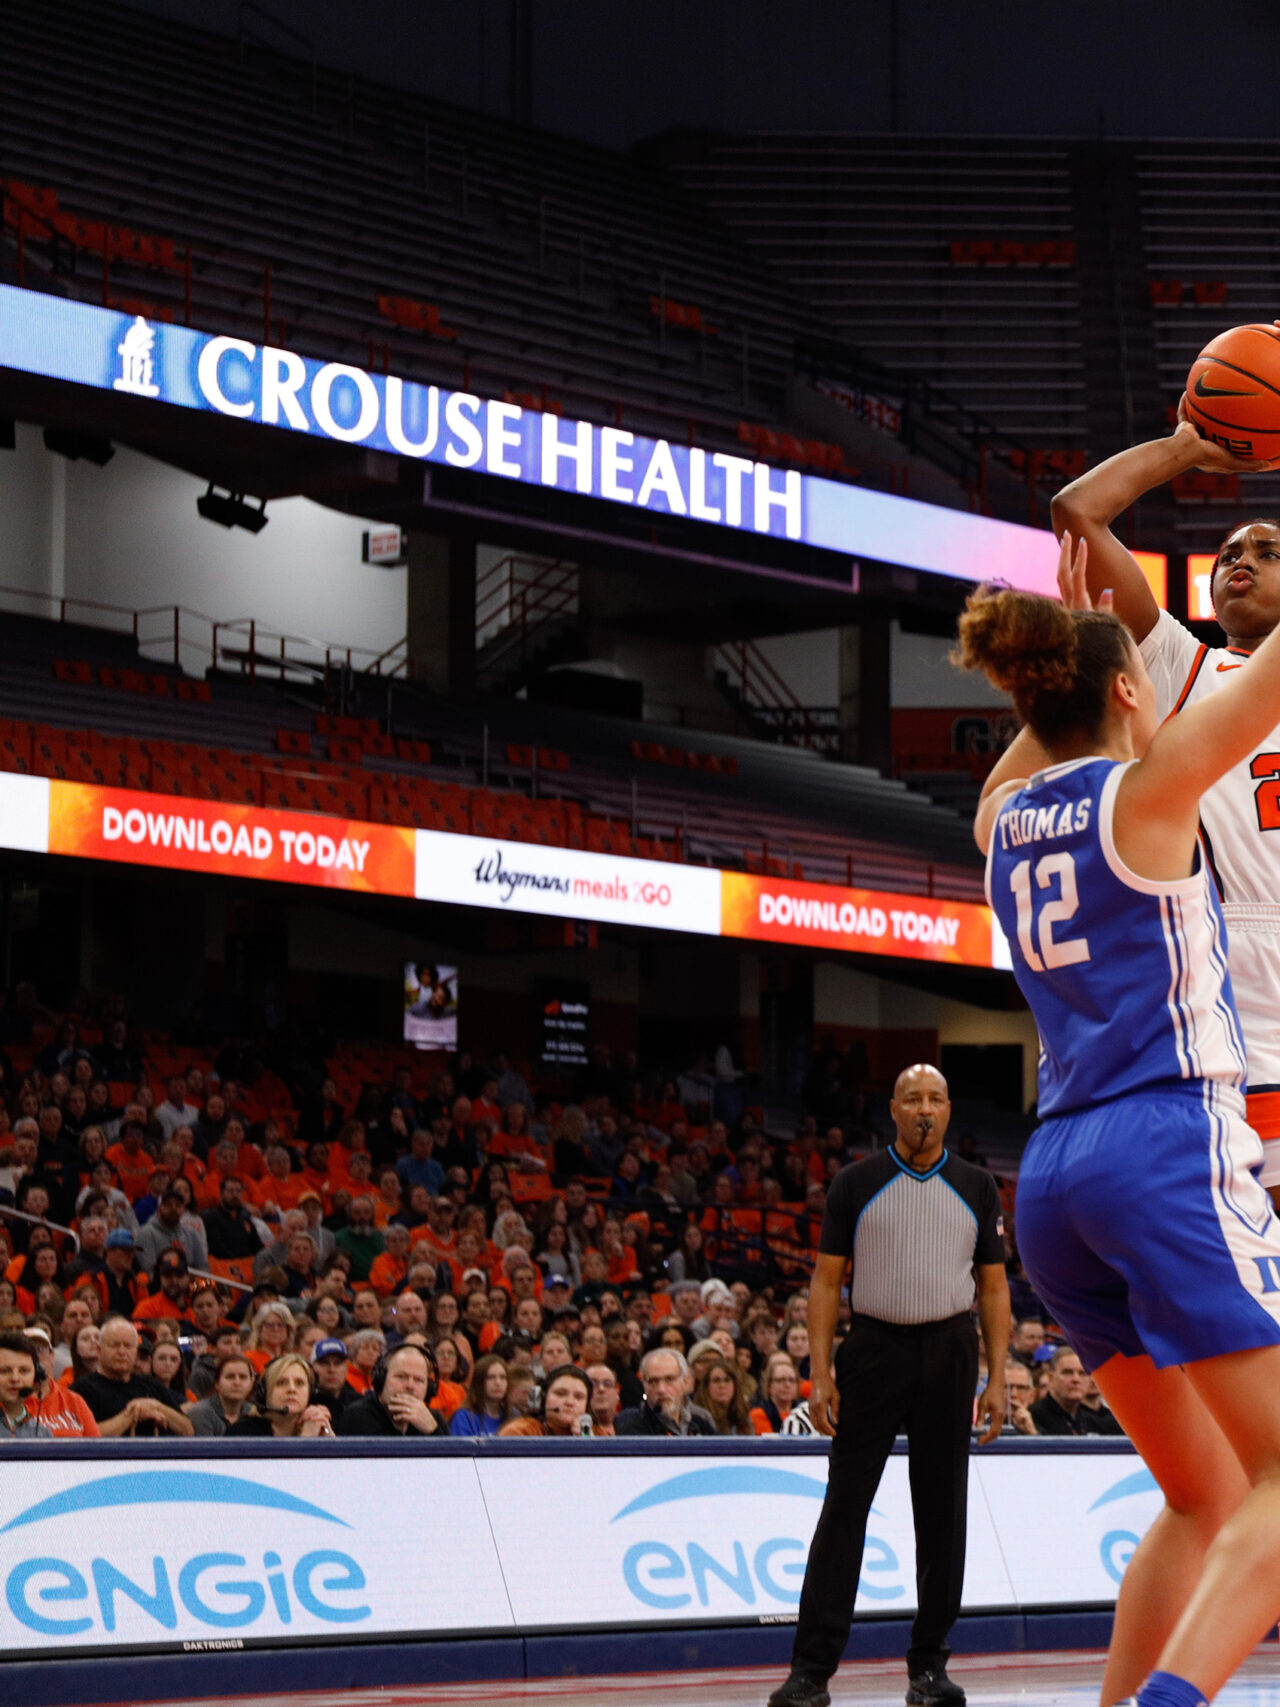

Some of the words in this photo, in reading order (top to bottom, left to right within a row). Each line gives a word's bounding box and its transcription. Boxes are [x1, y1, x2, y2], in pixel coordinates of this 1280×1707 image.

[197, 334, 523, 479] CROUSE
[541, 412, 802, 539] HEALTH
[102, 806, 273, 860] DOWNLOAD
[280, 830, 371, 873] TODAY
[474, 850, 570, 903] Wegmans
[574, 874, 629, 902] meals
[633, 881, 672, 907] 2GO
[758, 894, 887, 939] DOWNLOAD
[892, 908, 961, 948] TODAY
[998, 798, 1093, 851] THOMAS
[1009, 851, 1091, 972] 12
[183, 1639, 244, 1652] DAKTRONICS
